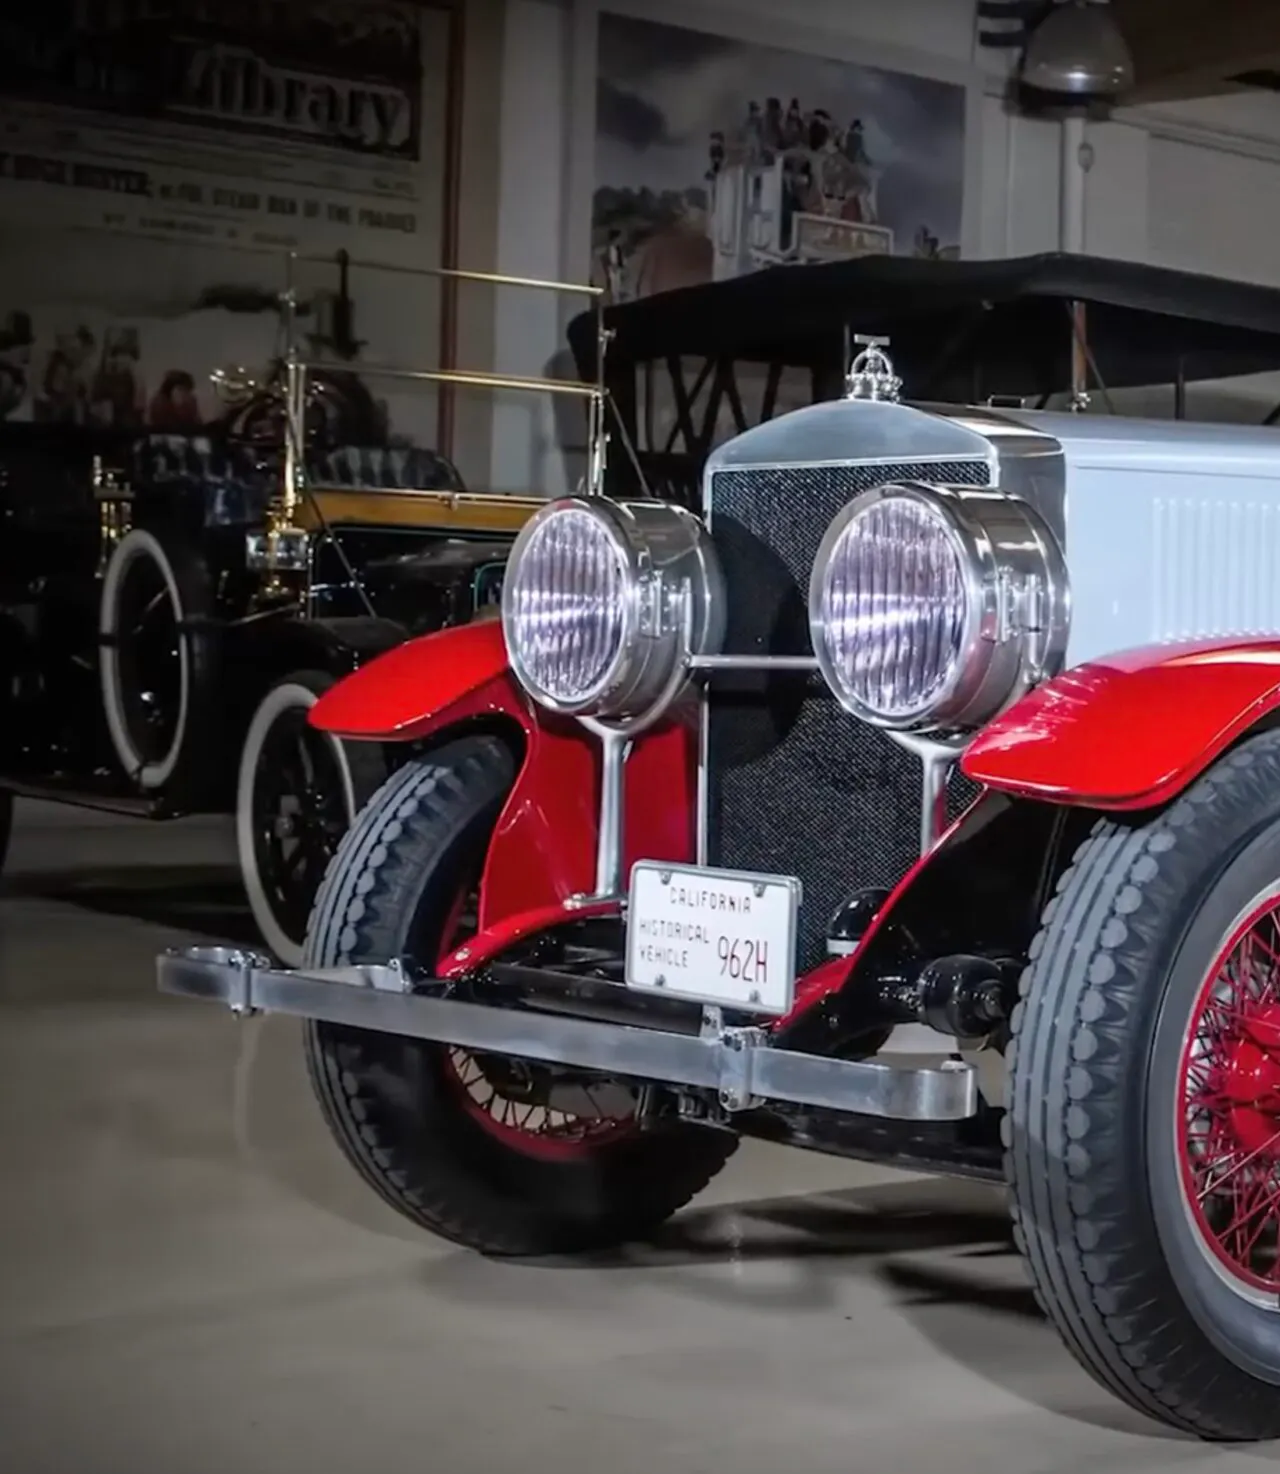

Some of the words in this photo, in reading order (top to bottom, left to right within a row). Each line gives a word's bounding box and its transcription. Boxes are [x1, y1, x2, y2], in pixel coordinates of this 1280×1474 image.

[670, 886, 751, 914] CALIFORNIA
[639, 917, 710, 944] HISTORICAL
[639, 944, 689, 968] VEHICLE
[717, 935, 769, 984] 962H
